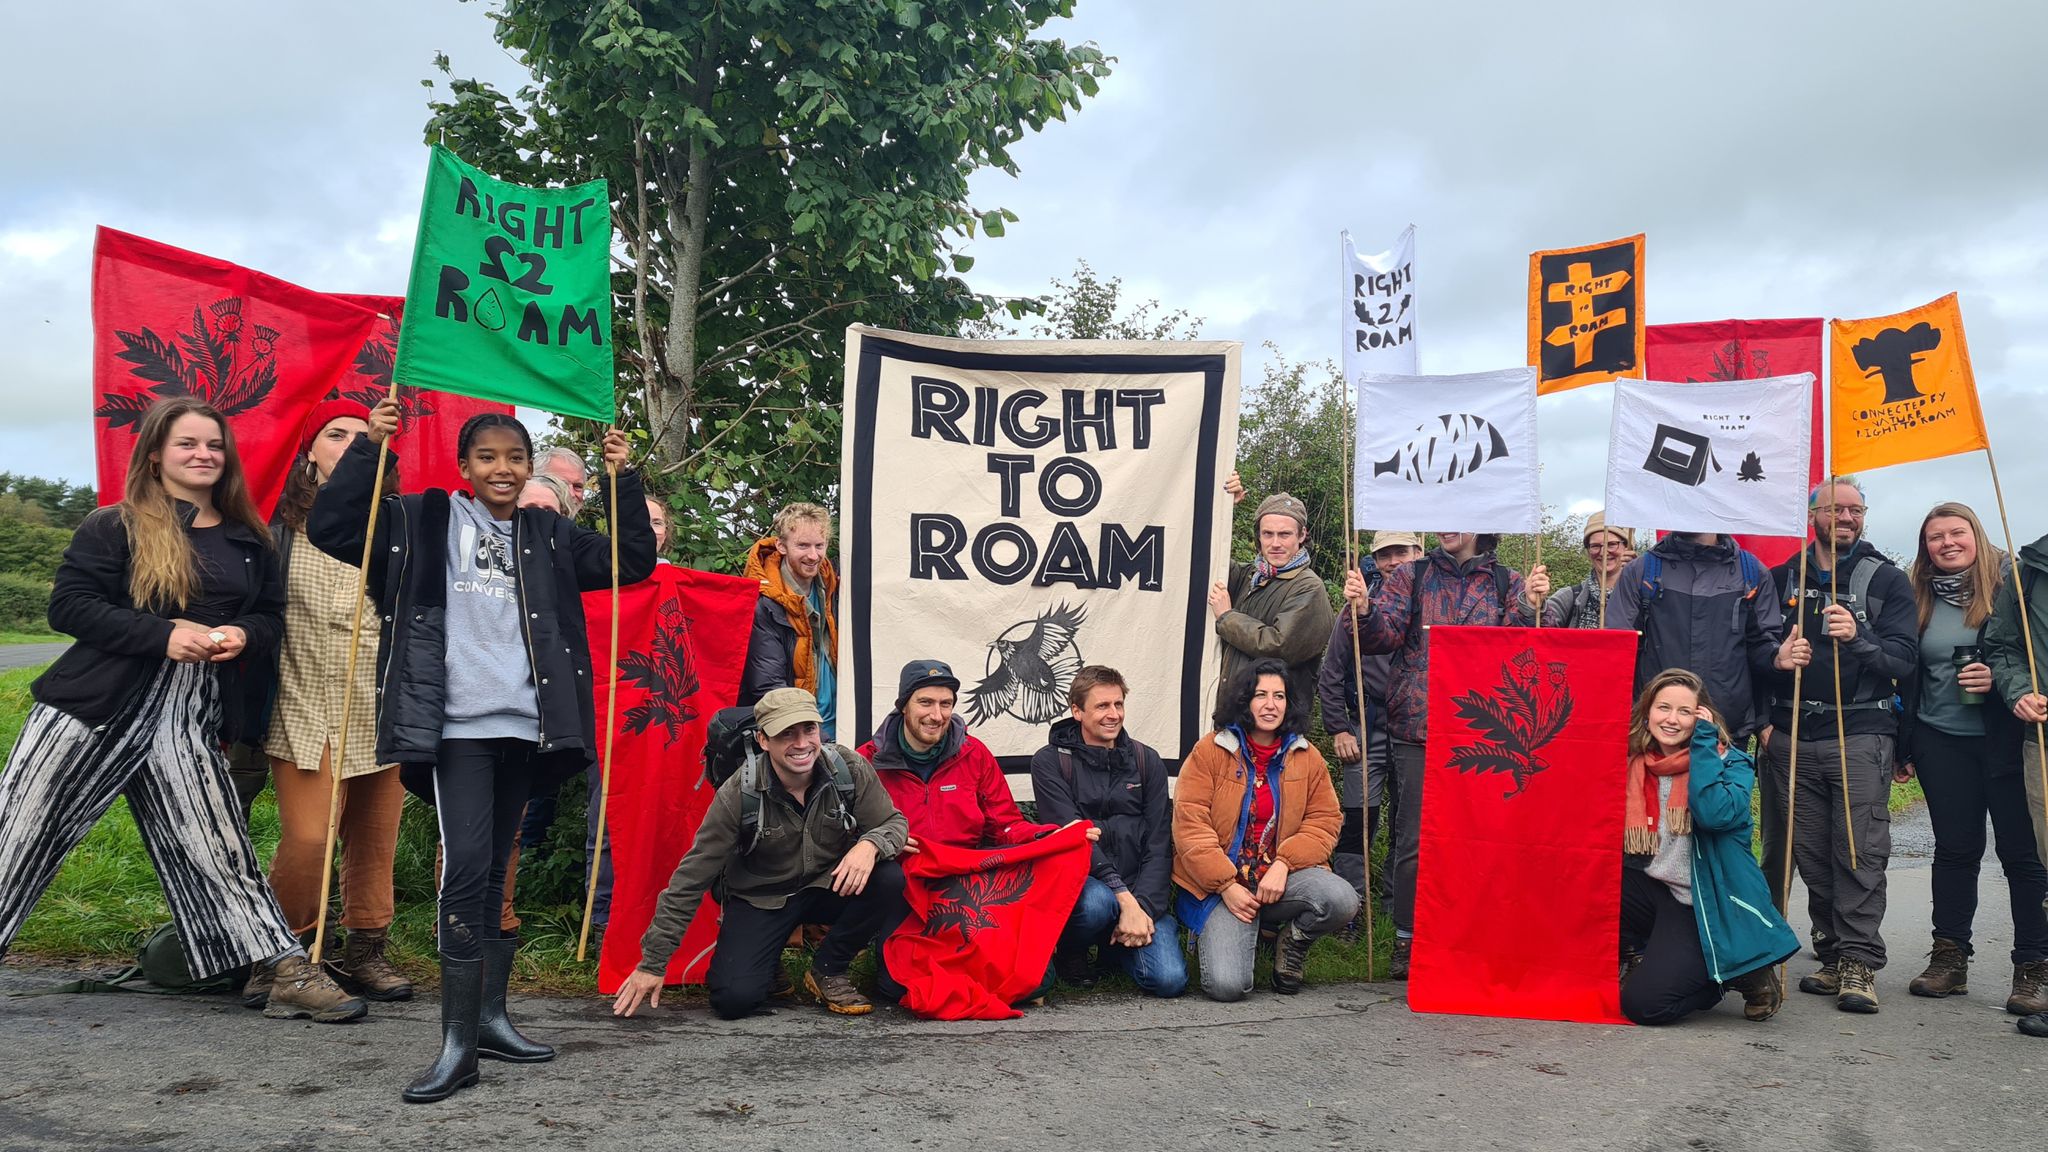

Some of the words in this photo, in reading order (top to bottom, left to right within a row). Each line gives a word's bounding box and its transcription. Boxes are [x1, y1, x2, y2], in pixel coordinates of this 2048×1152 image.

[455, 176, 595, 249] RIGHT
[1354, 262, 1412, 297] RIGHT
[1565, 277, 1612, 296] RIGHT
[1377, 303, 1394, 325] 2
[1568, 316, 1609, 338] ROAM
[1356, 321, 1412, 352] ROAM
[911, 375, 1165, 453] RIGHT
[1852, 399, 1926, 421] CONNECTED
[1901, 420, 1916, 429] TO
[1920, 408, 1956, 424] ROAM
[987, 453, 1102, 518] TO
[910, 513, 1165, 591] ROAM
[453, 580, 519, 604] CONVES
